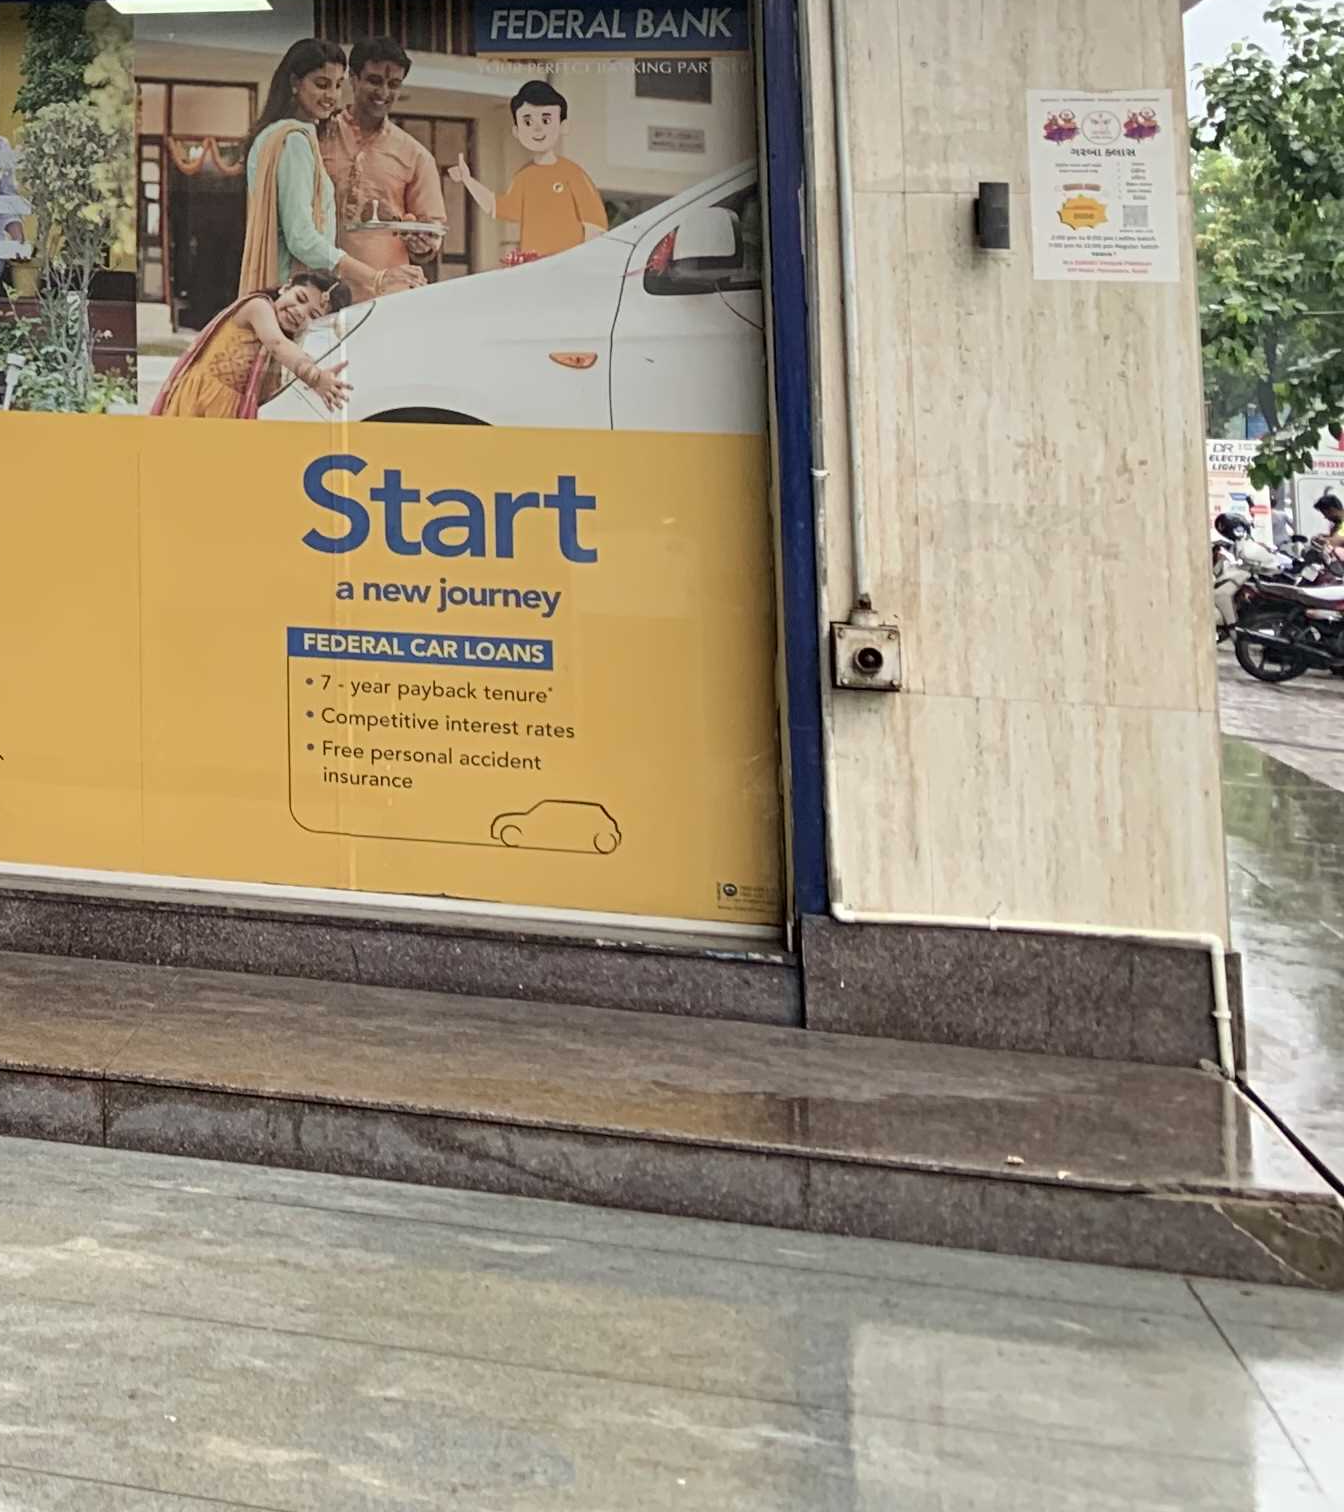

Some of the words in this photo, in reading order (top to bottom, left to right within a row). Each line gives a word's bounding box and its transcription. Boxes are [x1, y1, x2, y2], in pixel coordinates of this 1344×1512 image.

[490, 8, 627, 40] FEDERAL
[634, 7, 733, 39] BANK
[1209, 455, 1254, 463] ELECTRI
[301, 453, 599, 564] Start
[362, 581, 432, 604] new
[436, 577, 562, 619] journey
[302, 632, 405, 656] FEDERAL
[410, 637, 458, 660] CAR
[464, 642, 545, 664] LOANS
[350, 679, 391, 697] year
[397, 679, 477, 702] payback
[320, 707, 440, 732] Competitive
[445, 714, 520, 736] interest
[526, 722, 575, 740] rates
[321, 740, 365, 760] Free
[370, 745, 453, 768] personal
[458, 749, 542, 771] accident
[322, 767, 413, 789] insurance
